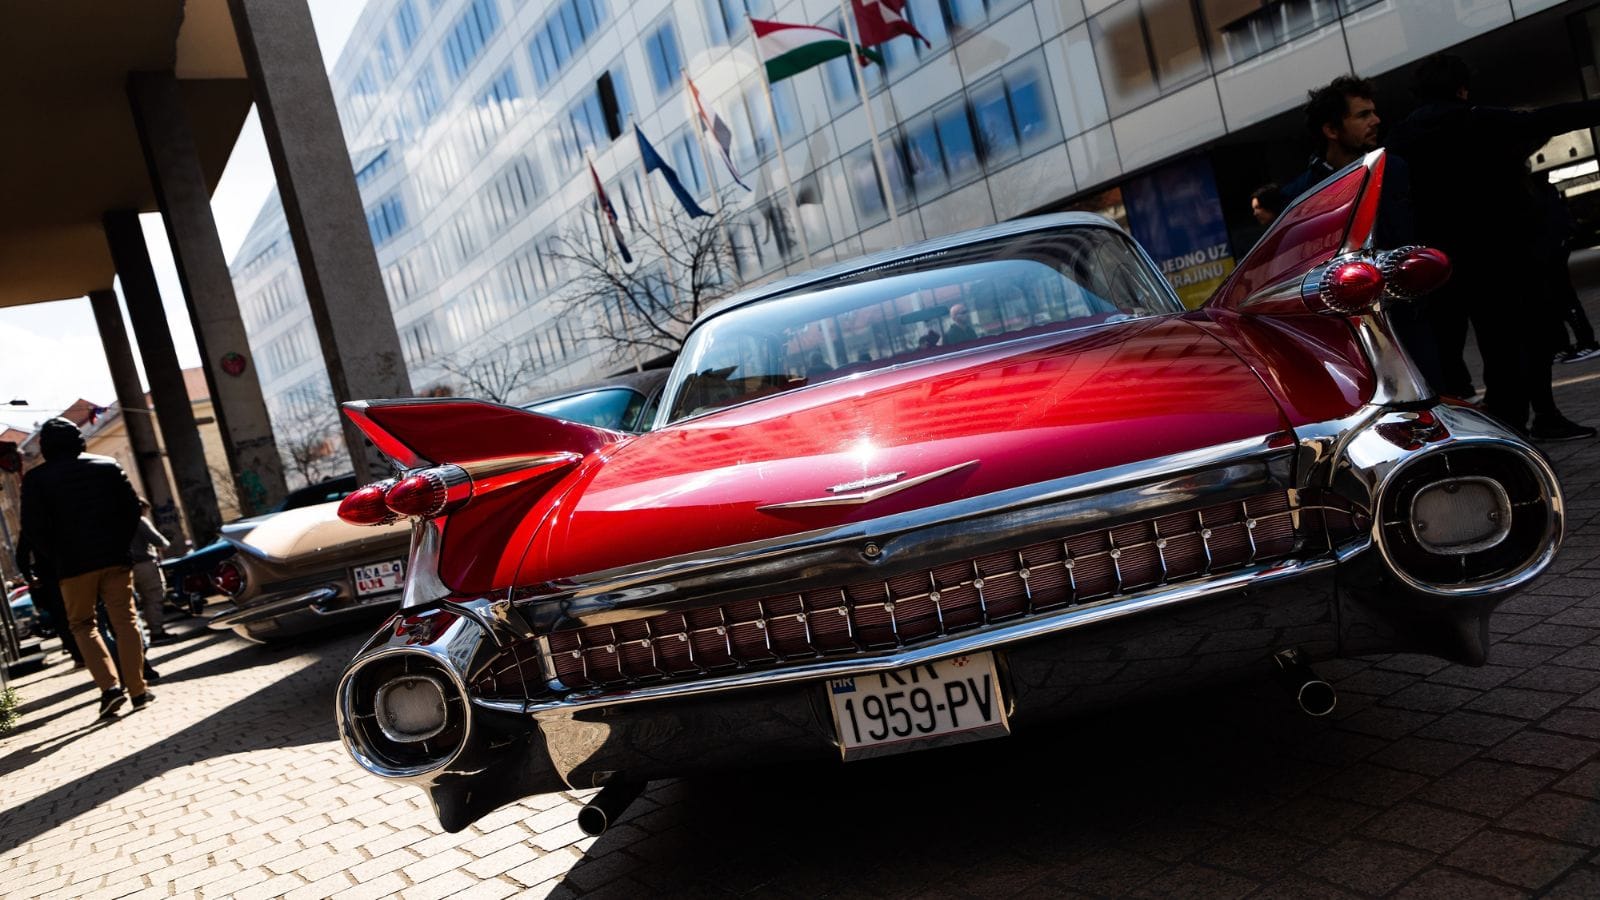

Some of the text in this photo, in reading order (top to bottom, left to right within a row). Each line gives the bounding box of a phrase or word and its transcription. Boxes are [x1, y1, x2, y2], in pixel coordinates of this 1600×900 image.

[1161, 243, 1229, 273] JEDNO UZ
[1168, 263, 1223, 288] RAJINU
[845, 674, 992, 743] 1959-PV
